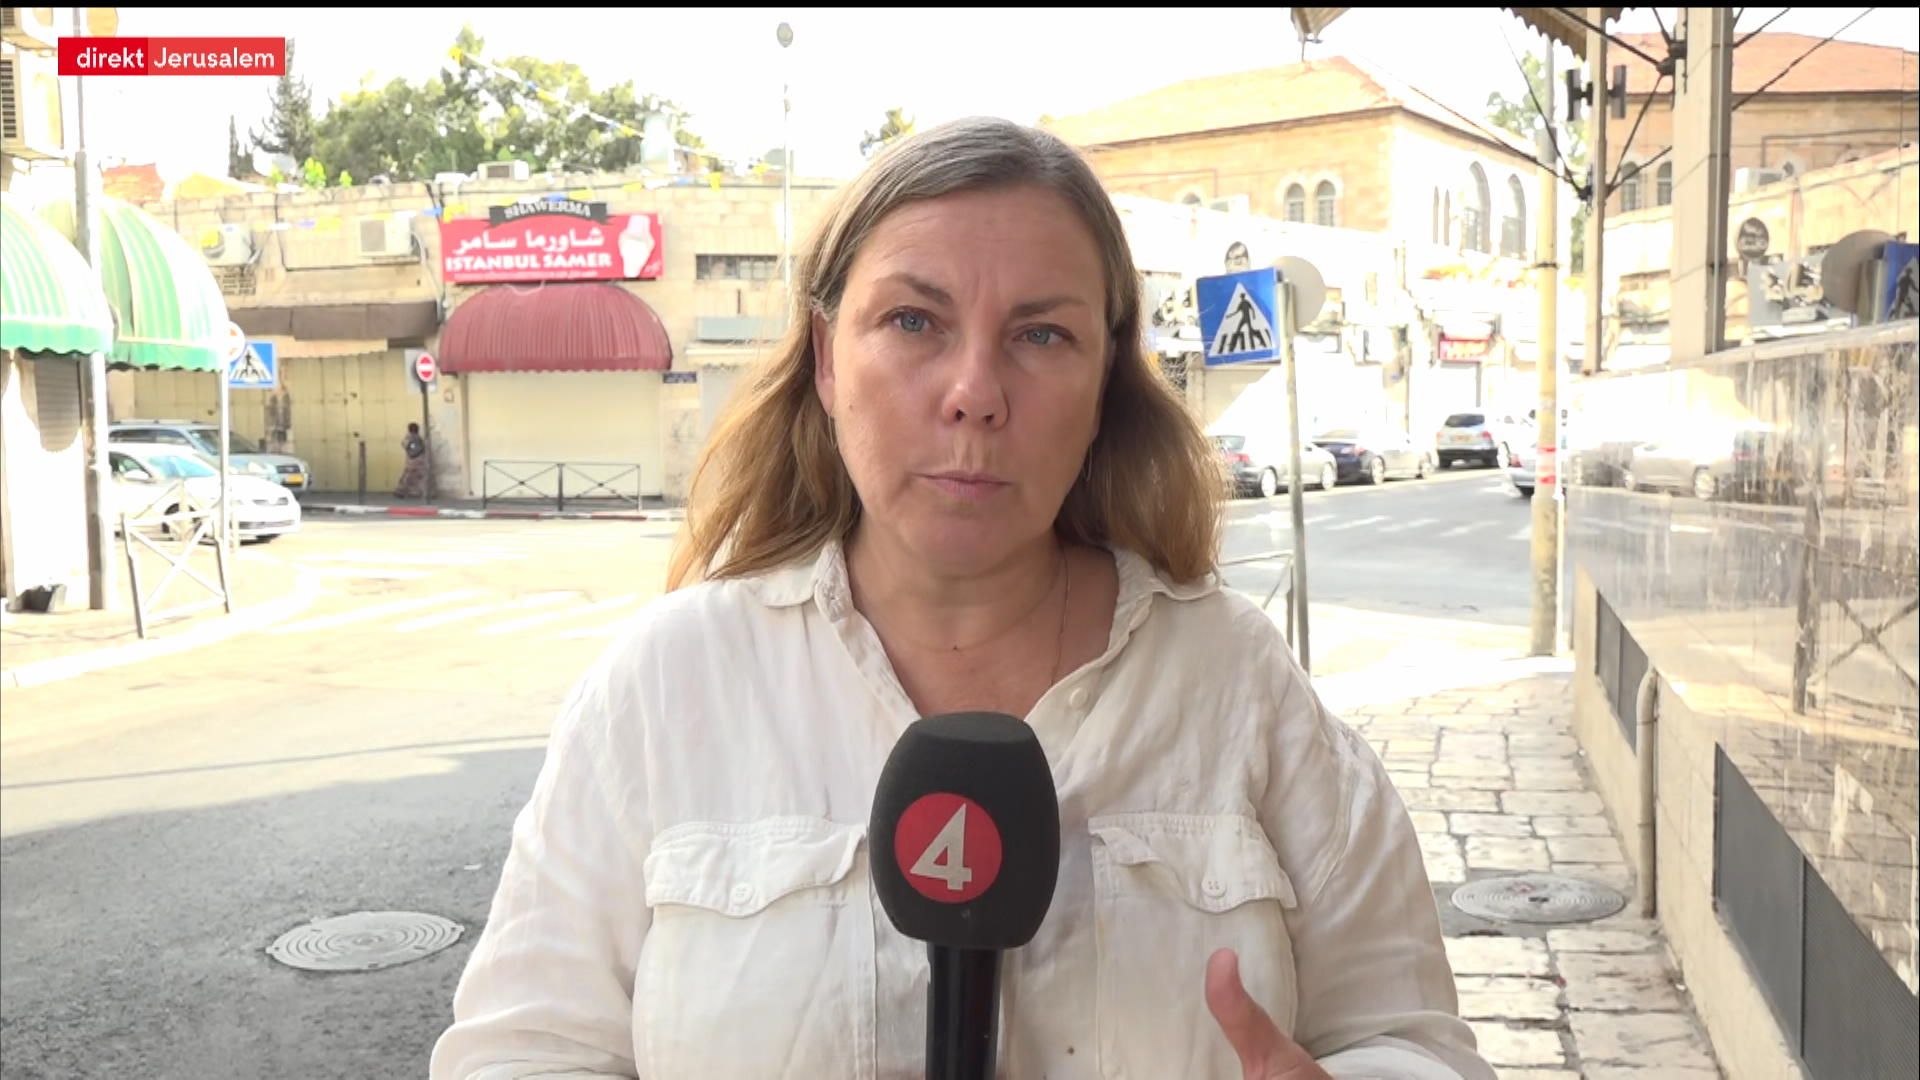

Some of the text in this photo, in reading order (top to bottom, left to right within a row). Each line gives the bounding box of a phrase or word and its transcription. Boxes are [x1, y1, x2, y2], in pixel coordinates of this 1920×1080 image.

[504, 200, 592, 219] SHAWERMA
[452, 227, 605, 255] شاورما سامر
[445, 251, 613, 272] ISTANBUL SAMER
[909, 803, 972, 890] 4
